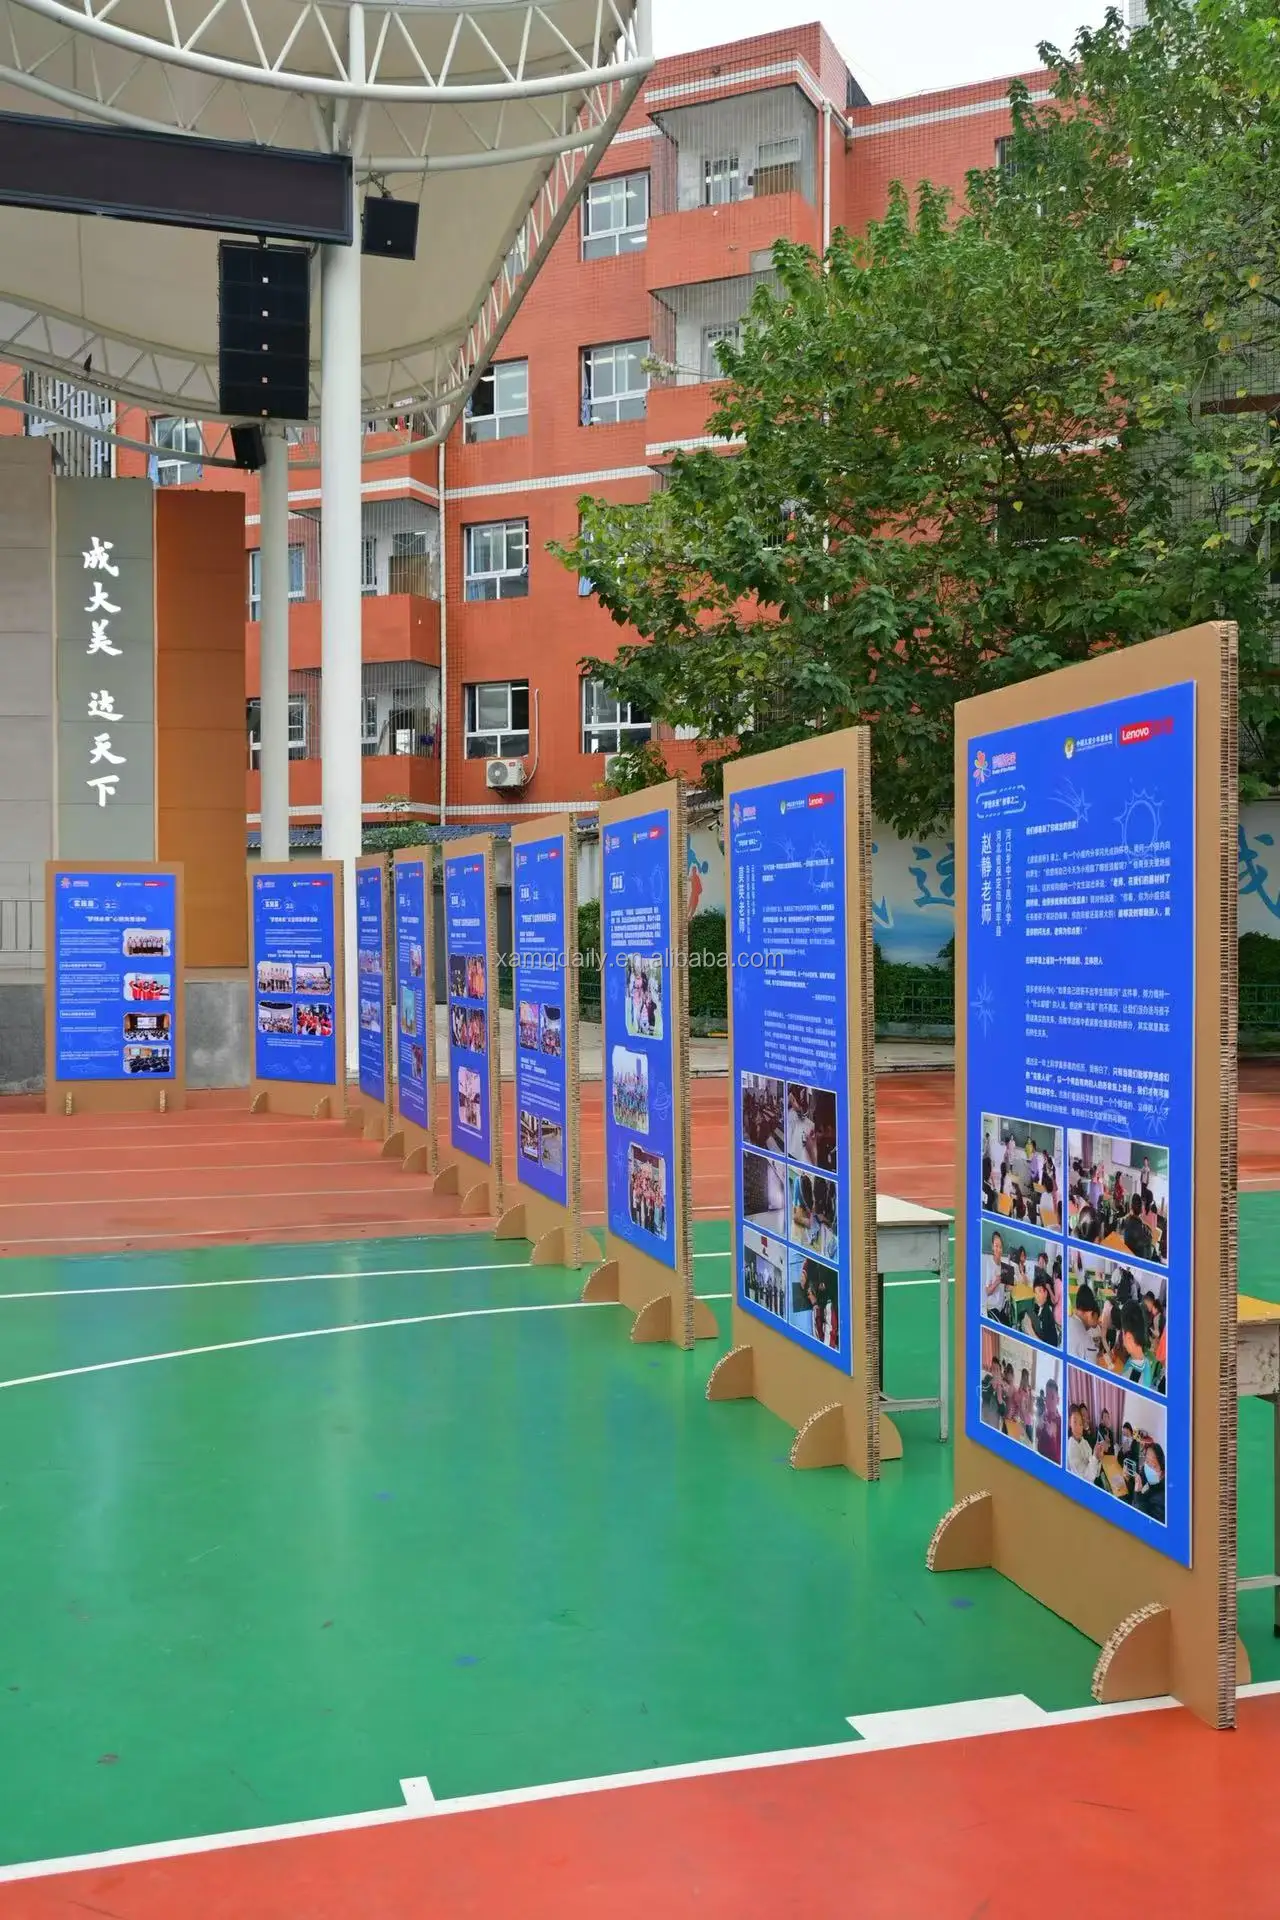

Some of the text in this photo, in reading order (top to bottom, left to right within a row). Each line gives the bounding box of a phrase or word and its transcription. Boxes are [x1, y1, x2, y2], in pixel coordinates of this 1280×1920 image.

[83, 537, 122, 655] 成大美
[1122, 726, 1149, 740] Lenovo
